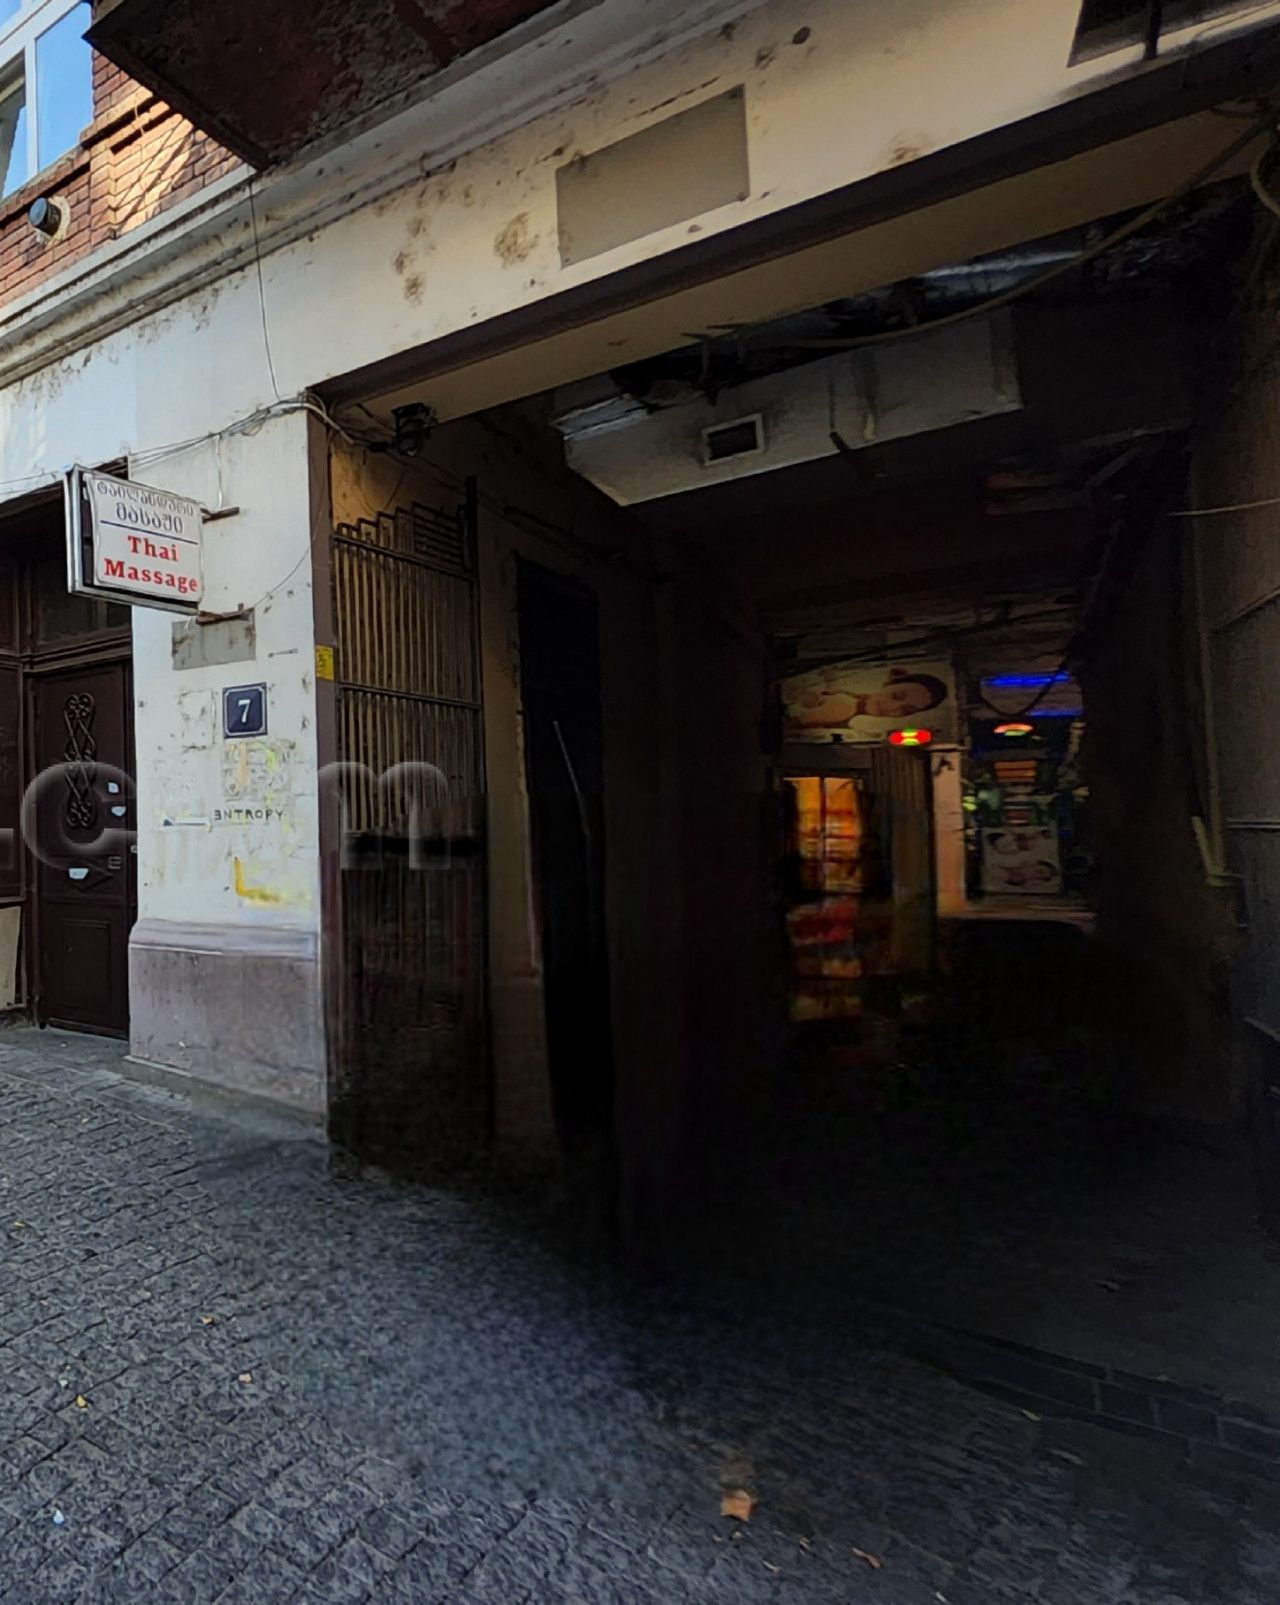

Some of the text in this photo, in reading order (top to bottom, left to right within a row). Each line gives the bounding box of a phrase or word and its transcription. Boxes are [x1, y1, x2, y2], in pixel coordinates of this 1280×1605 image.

[128, 535, 179, 562] Thai
[103, 558, 199, 594] Massage
[238, 699, 252, 723] 7
